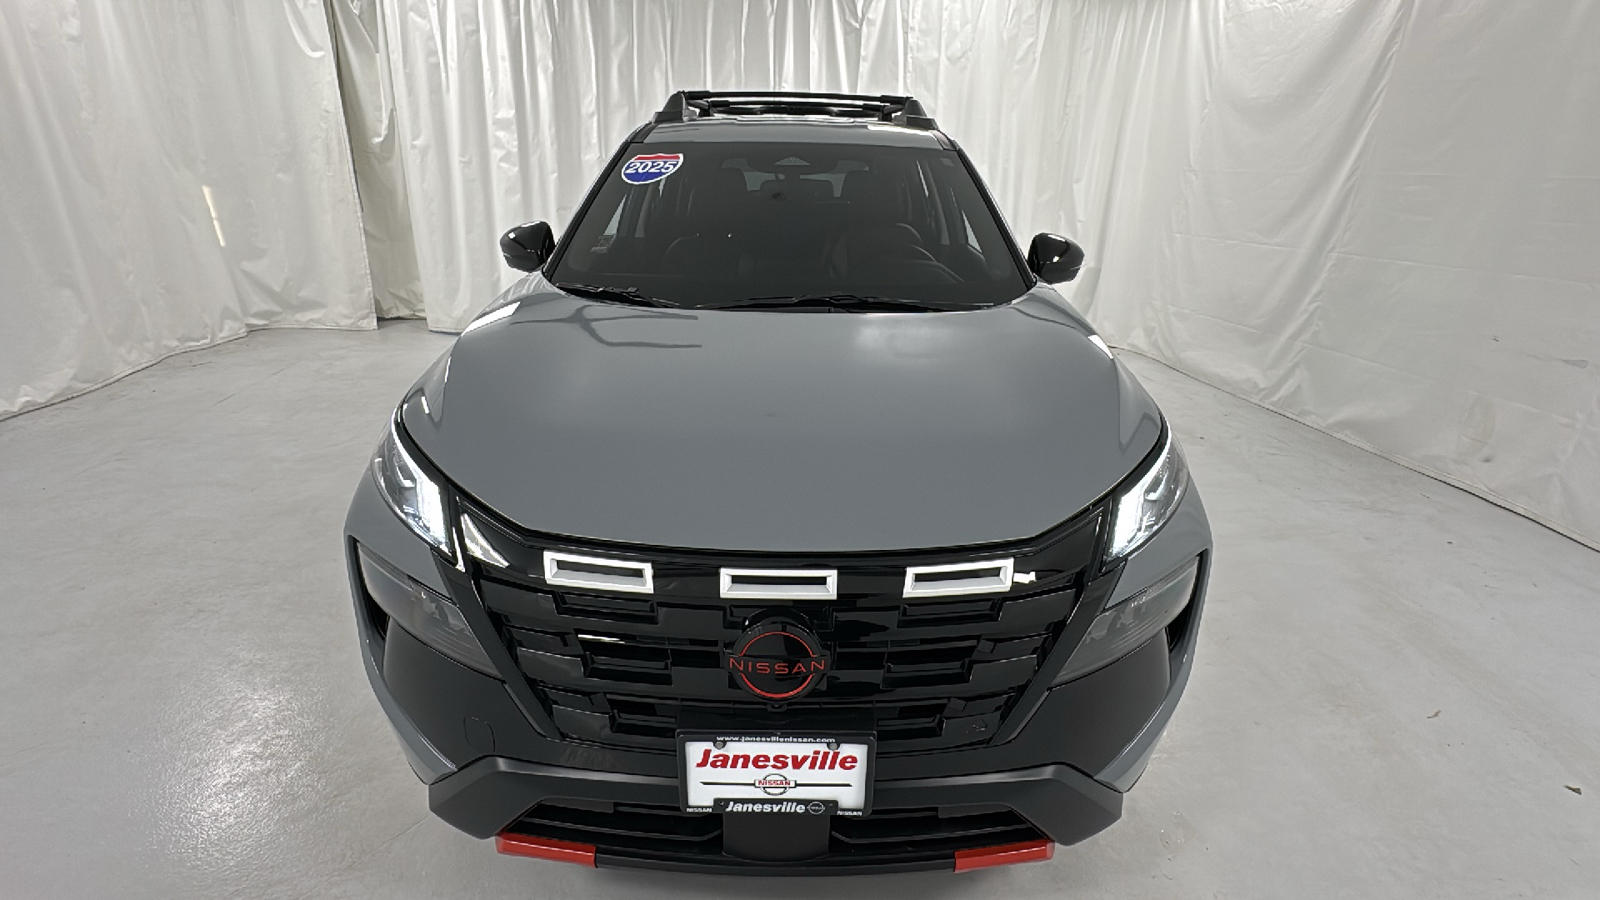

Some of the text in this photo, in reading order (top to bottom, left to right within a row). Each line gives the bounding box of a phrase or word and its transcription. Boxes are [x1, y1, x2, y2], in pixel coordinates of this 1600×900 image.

[625, 161, 677, 173] 2025
[729, 658, 825, 674] NISSAN
[695, 749, 858, 770] Janesville
[725, 801, 806, 813] Janesville
